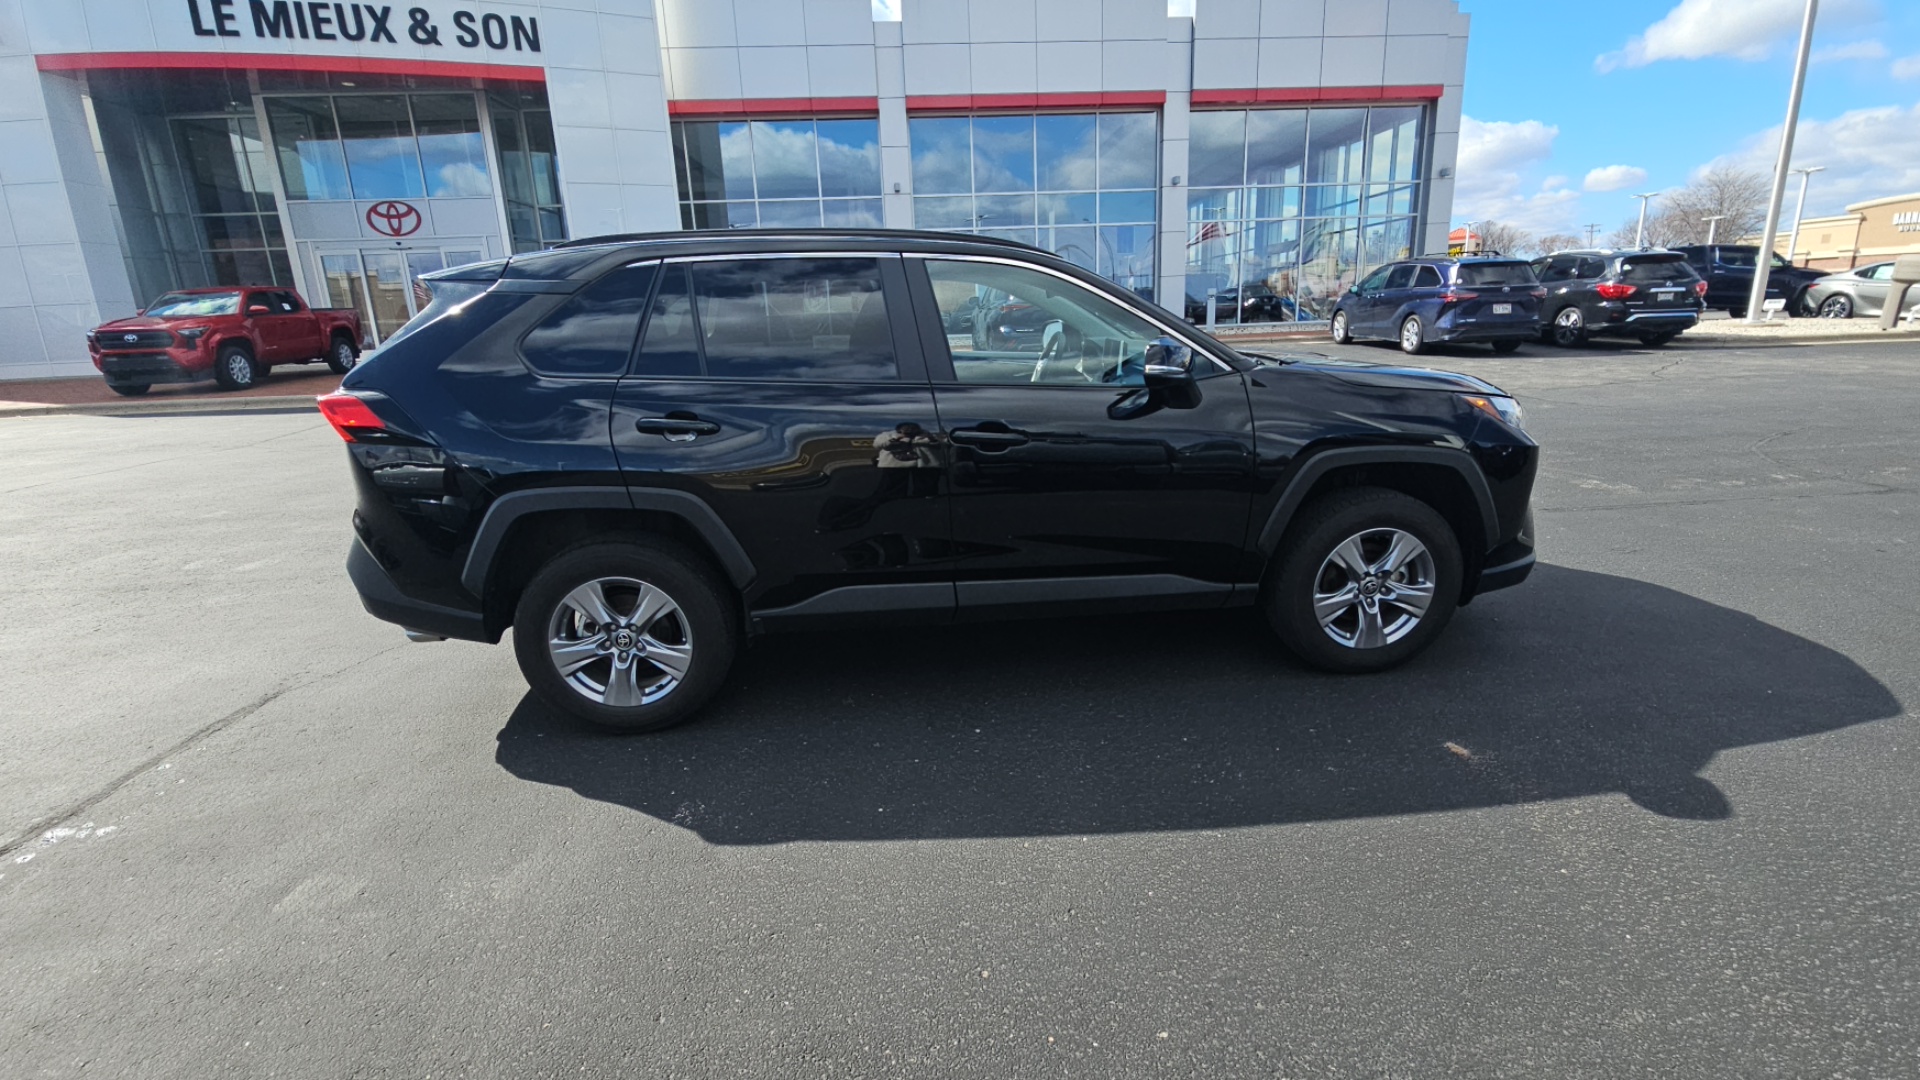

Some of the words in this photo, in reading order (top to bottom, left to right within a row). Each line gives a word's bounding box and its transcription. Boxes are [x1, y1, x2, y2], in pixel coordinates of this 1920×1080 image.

[187, 0, 241, 37] LE
[249, 0, 397, 43] MIEUX
[408, 7, 443, 46] &
[453, 10, 541, 52] SON
